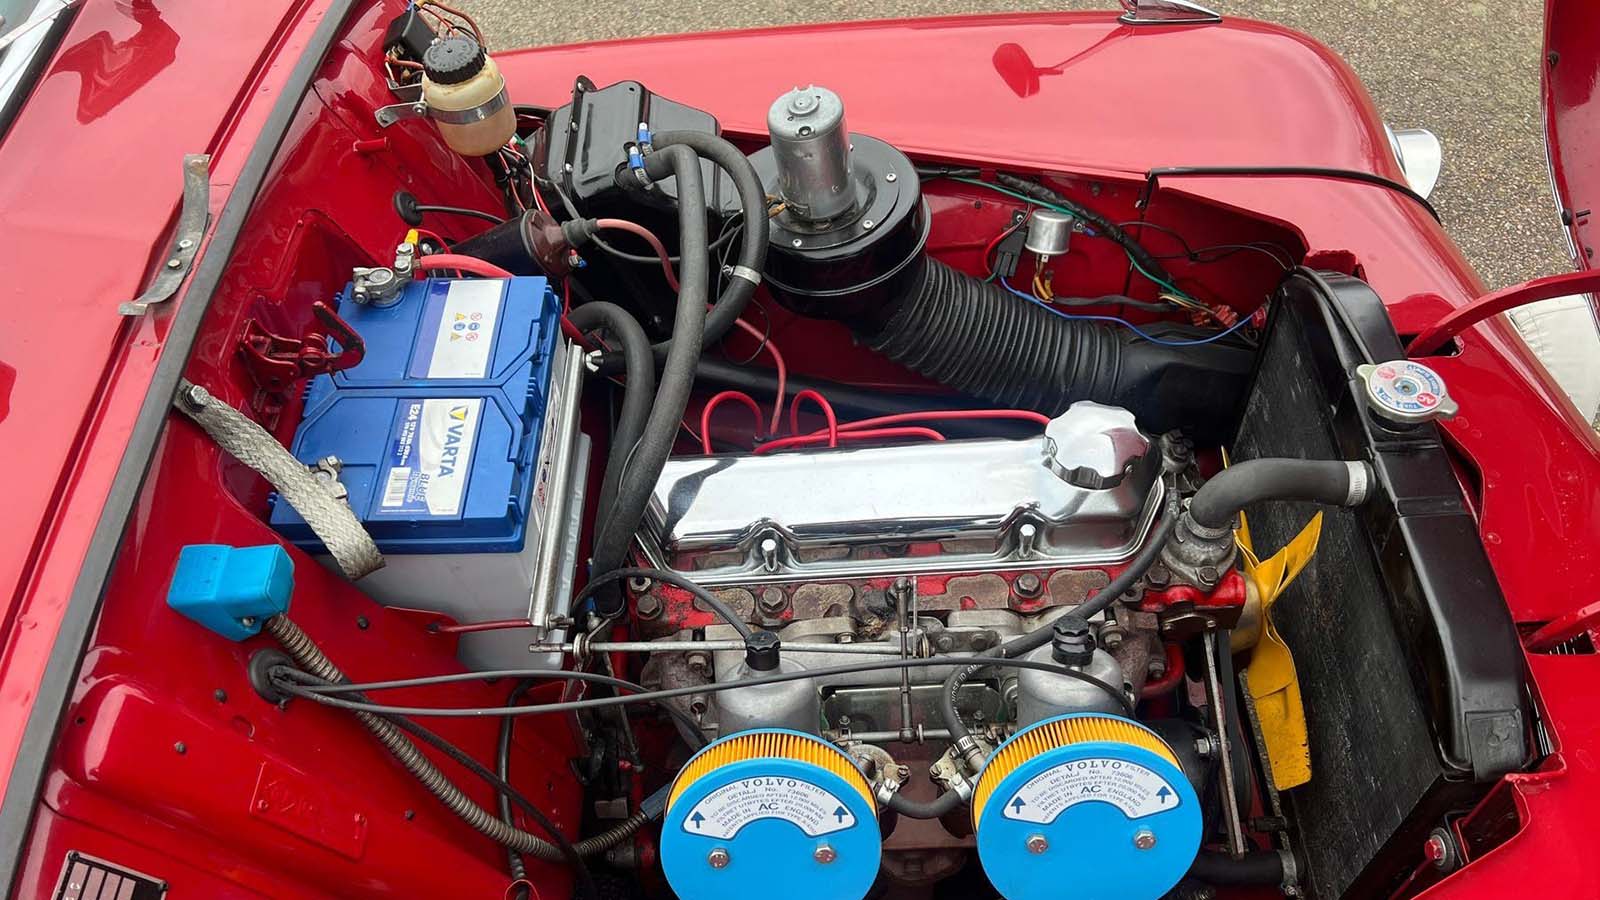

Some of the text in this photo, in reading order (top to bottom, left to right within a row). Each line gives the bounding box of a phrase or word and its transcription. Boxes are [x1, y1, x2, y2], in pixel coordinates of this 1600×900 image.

[408, 404, 421, 420] E24
[438, 423, 464, 477] VARTA
[416, 473, 430, 501] BLUE
[1027, 761, 1150, 790] ORIGINAL VOLVO FILTER
[704, 779, 826, 804] ORIGINAL VOLVO FILTER
[1042, 796, 1062, 811] MADE
[1080, 786, 1101, 794] AC
[1108, 789, 1142, 807] ENGLAND
[722, 812, 741, 826] MADE
[785, 806, 820, 826] ENGLAND
